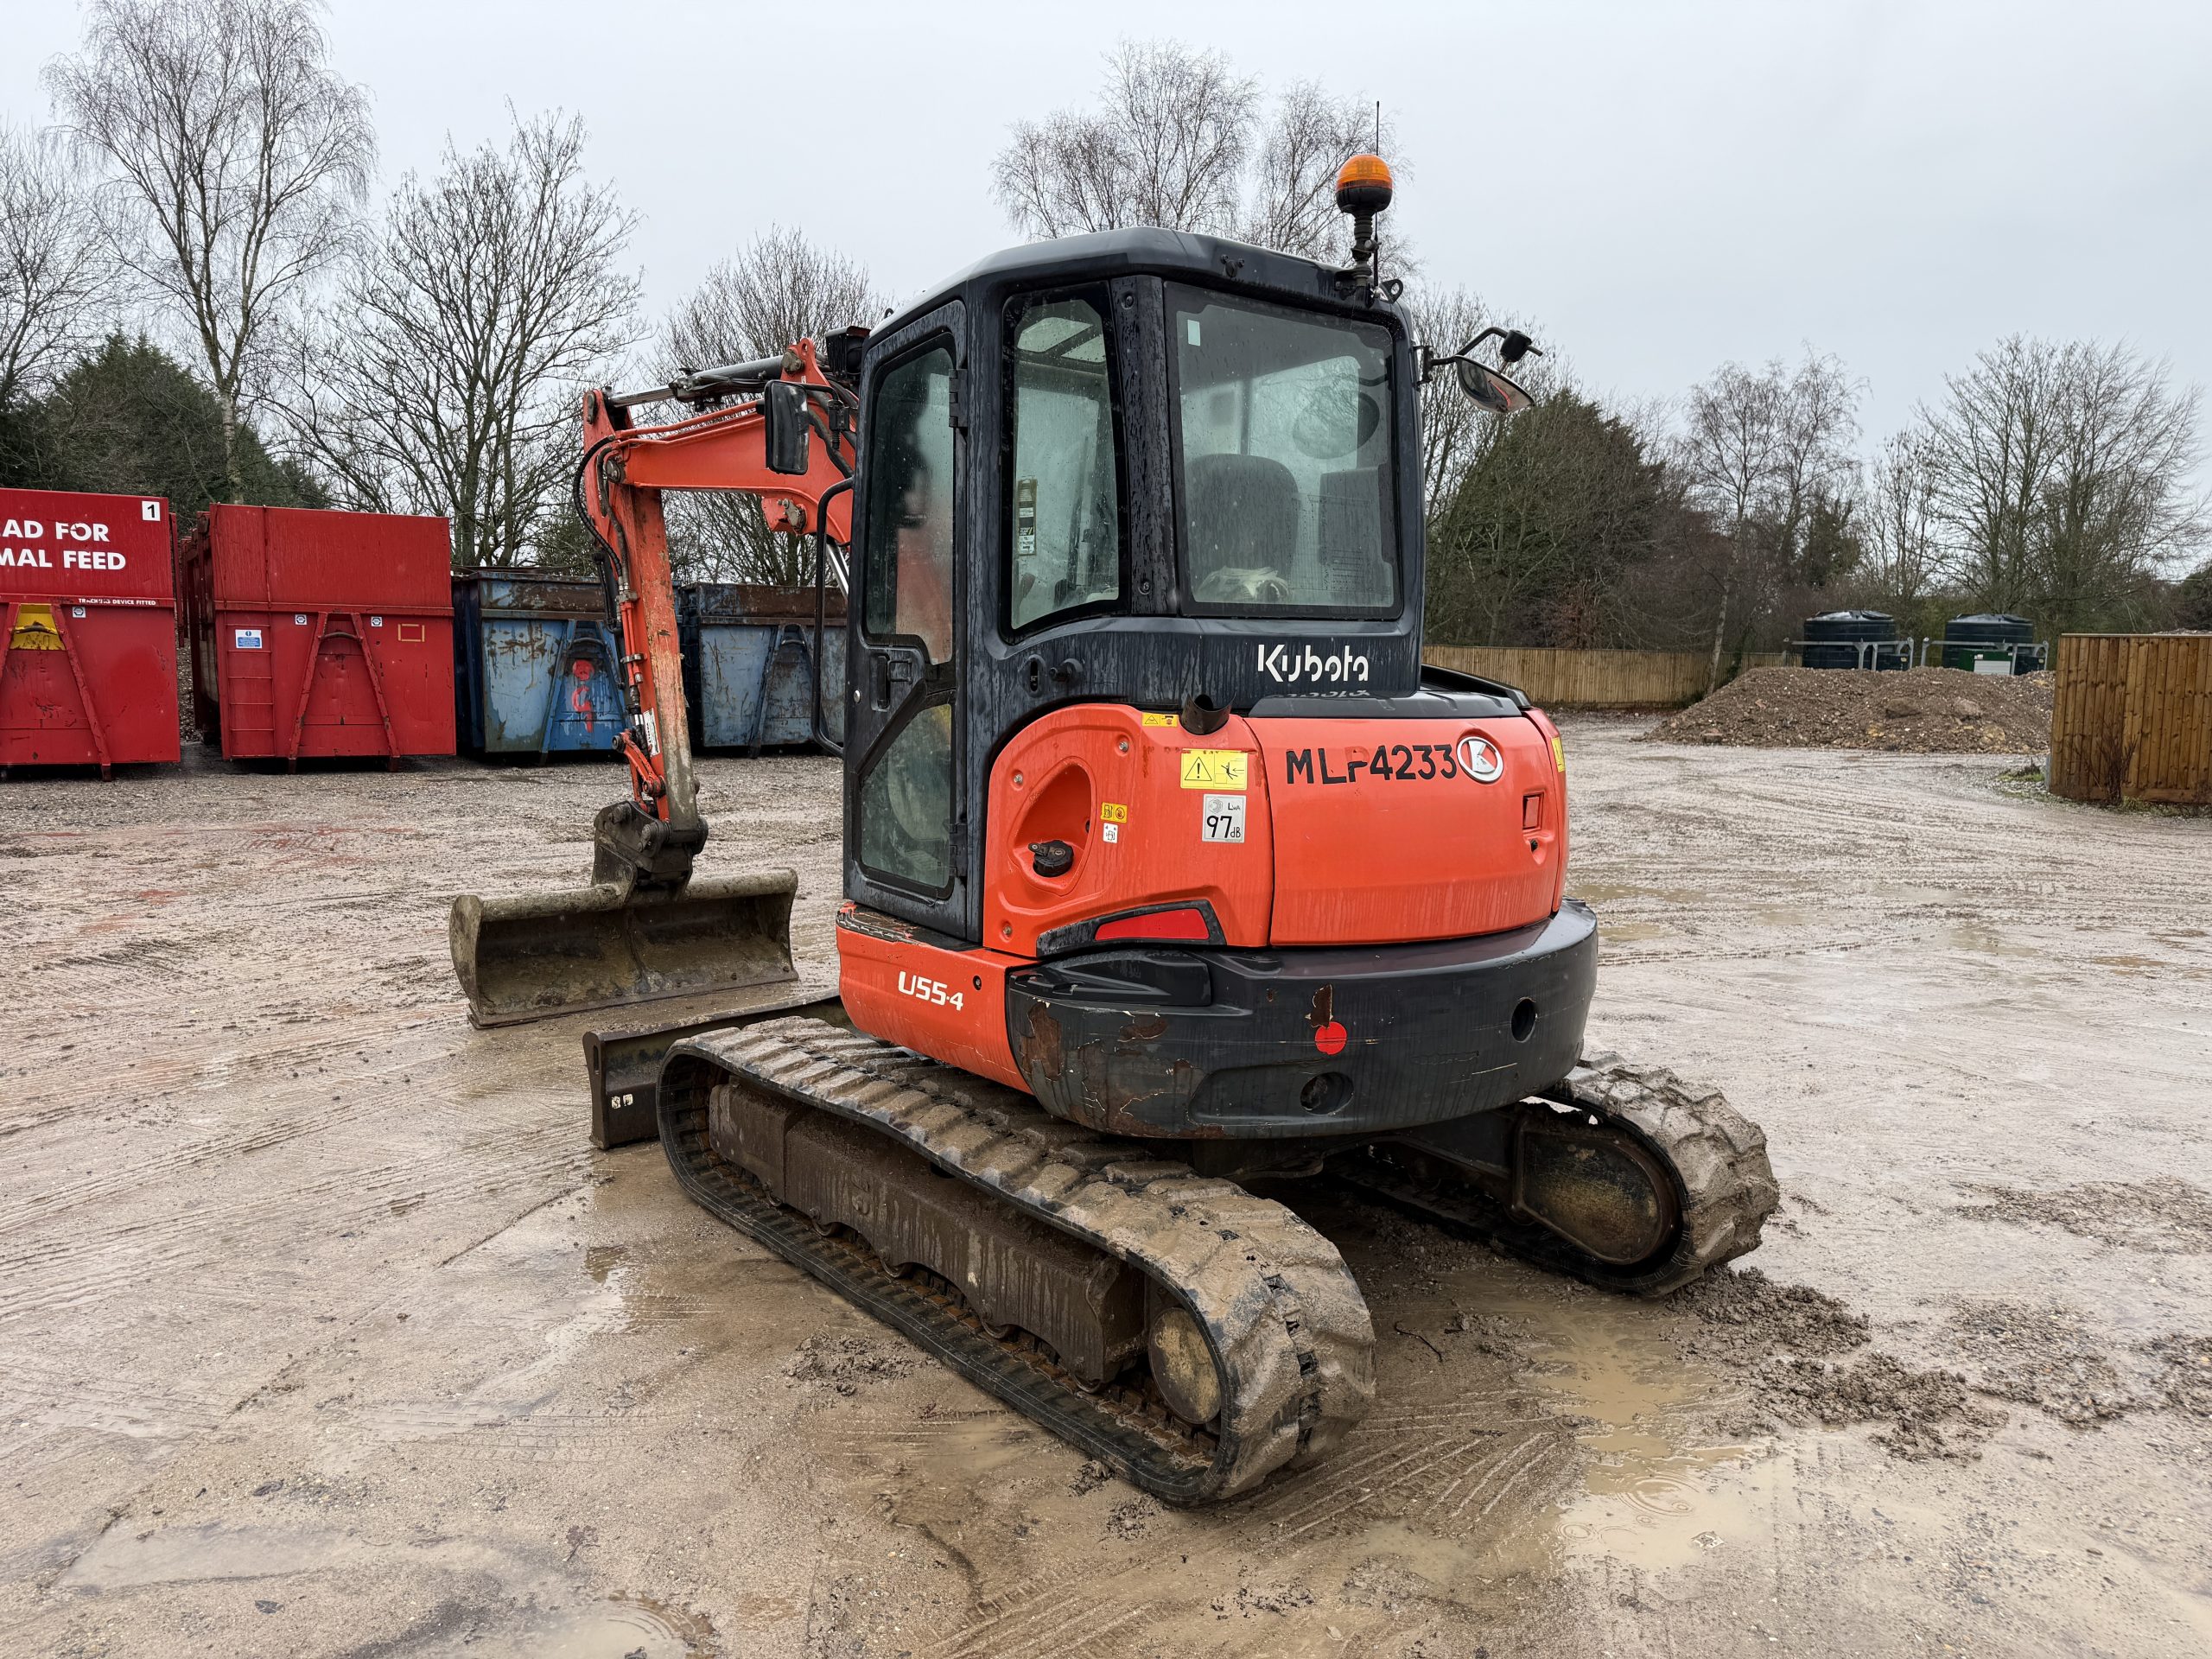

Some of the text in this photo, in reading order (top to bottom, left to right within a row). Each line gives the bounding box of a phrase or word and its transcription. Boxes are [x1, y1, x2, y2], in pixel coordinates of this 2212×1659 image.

[148, 504, 156, 518] 1
[0, 518, 111, 542] AD FOR
[0, 548, 126, 570] MAL FEED
[1257, 644, 1369, 682] Kubota
[1286, 744, 1458, 785] MLP4233
[898, 970, 964, 1012] U55-4
